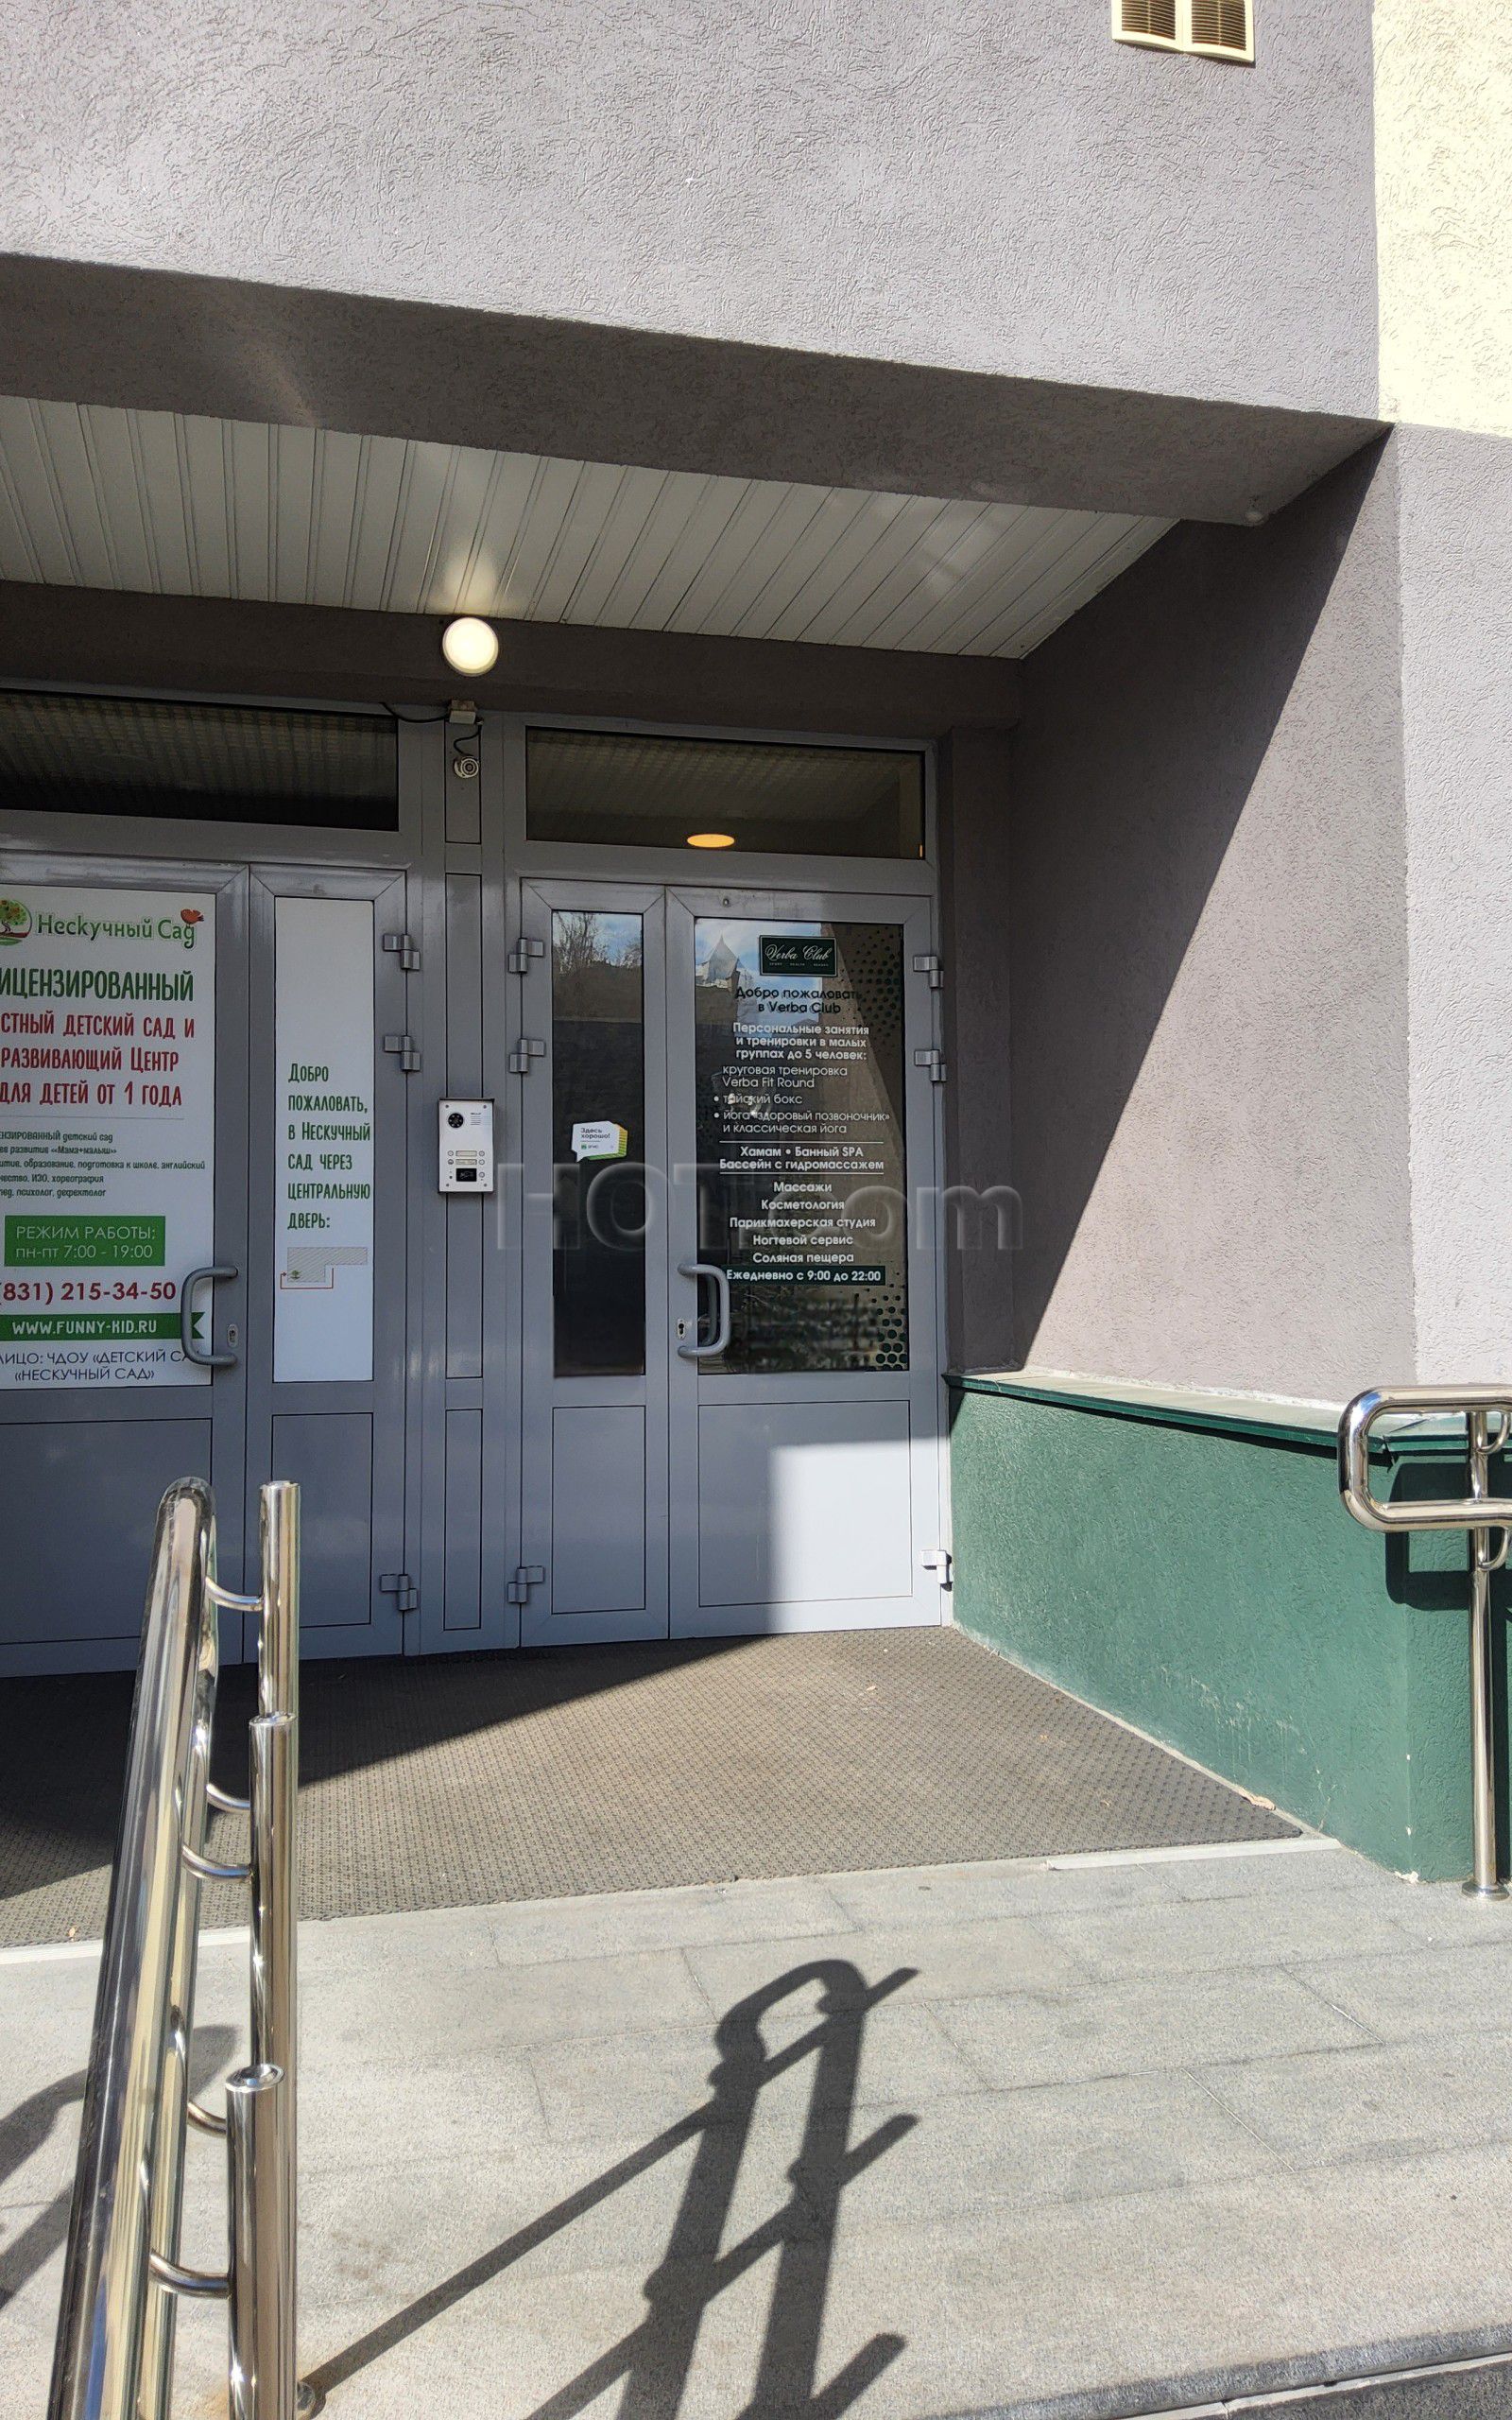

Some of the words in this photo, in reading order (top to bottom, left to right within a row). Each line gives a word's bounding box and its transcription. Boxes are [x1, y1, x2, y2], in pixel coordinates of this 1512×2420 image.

[38, 914, 152, 942] Нескучный
[158, 919, 196, 949] Сад
[765, 943, 799, 961] Verba
[802, 944, 833, 960] Club
[734, 987, 780, 1000] Добро
[758, 1004, 765, 1012] в
[768, 1001, 808, 1013] Verba
[811, 1002, 841, 1014] Club
[1, 1010, 55, 1035] СТНЫЙ
[62, 1012, 134, 1038] ДЕТСКИЙ
[143, 1017, 176, 1040] САД
[184, 1018, 195, 1038] И
[732, 1022, 822, 1035] Персональные
[824, 1026, 869, 1035] занятия
[747, 1037, 816, 1048] тренировки
[829, 1039, 867, 1047] малых
[1, 1046, 122, 1071] РАЗВИВАЮЩИЙ
[736, 1049, 784, 1061] группах
[787, 1050, 802, 1060] до
[805, 1049, 812, 1059] 5
[815, 1050, 867, 1060] человек:
[722, 1065, 776, 1077] круговая
[778, 1066, 848, 1078] тренировка
[722, 1077, 758, 1087] Verba
[762, 1077, 774, 1087] Fit
[777, 1078, 815, 1088] Round
[0, 1082, 31, 1104] ДЛЯ
[40, 1080, 89, 1105] ДЕТЕЙ
[97, 1084, 115, 1104] ОТ
[124, 1080, 133, 1104] 1
[142, 1084, 182, 1107] ГОДА
[773, 1094, 803, 1104] бокс
[287, 1095, 368, 1114] ПОЖАЛОВАТЬ,
[723, 1110, 750, 1120] йога
[815, 1112, 890, 1122] позвоночник»
[723, 1125, 730, 1133] и
[733, 1124, 817, 1133] классическая
[819, 1123, 847, 1133] йога
[62, 1132, 97, 1143] детский
[99, 1133, 113, 1143] сад
[740, 1146, 782, 1157] Хамам
[795, 1146, 840, 1157] Банный
[842, 1147, 864, 1157] SPA
[77, 1161, 124, 1170] подготовка
[161, 1161, 205, 1169] английский
[287, 1153, 313, 1171] САД
[319, 1153, 352, 1170] ЧЕРЕЗ
[719, 1158, 772, 1170] Бассейн
[775, 1161, 782, 1169] с
[785, 1161, 885, 1172] гидромассажем
[51, 1175, 104, 1184] хореография
[57, 1189, 106, 1199] дефектолог
[287, 1183, 370, 1201] ЦЕНТРАЛЬНУЮ
[773, 1182, 832, 1193] Массажи
[761, 1199, 845, 1211] Косметология
[287, 1212, 331, 1230] ДВЕРЬ:
[730, 1217, 833, 1230] Парикмахерская
[836, 1219, 876, 1230] студия
[16, 1226, 78, 1239] РЕЖИМ
[84, 1226, 156, 1240] РАБОТЫ:
[753, 1235, 807, 1246] Ногтевой
[810, 1236, 853, 1248] сервис
[16, 1248, 59, 1258] пн-пт
[63, 1245, 96, 1258] 7:00
[112, 1245, 153, 1258] 19:00
[752, 1253, 803, 1264] Соляная
[806, 1253, 854, 1265] пещера
[726, 1270, 794, 1282] Ежедневно
[797, 1272, 804, 1281] с
[807, 1270, 831, 1281] 9:00
[833, 1271, 849, 1283] до
[851, 1270, 881, 1282] 22:00
[60, 1281, 177, 1301] 215-34-50
[11, 1320, 157, 1335] WWW.FUNNY-KID.RU
[47, 1352, 89, 1365] ЧДОУ
[93, 1348, 166, 1364] «ДЕТСКИЙ
[14, 1366, 110, 1381] «НЕСКУЧНЫЙ
[114, 1367, 155, 1380] САД»
